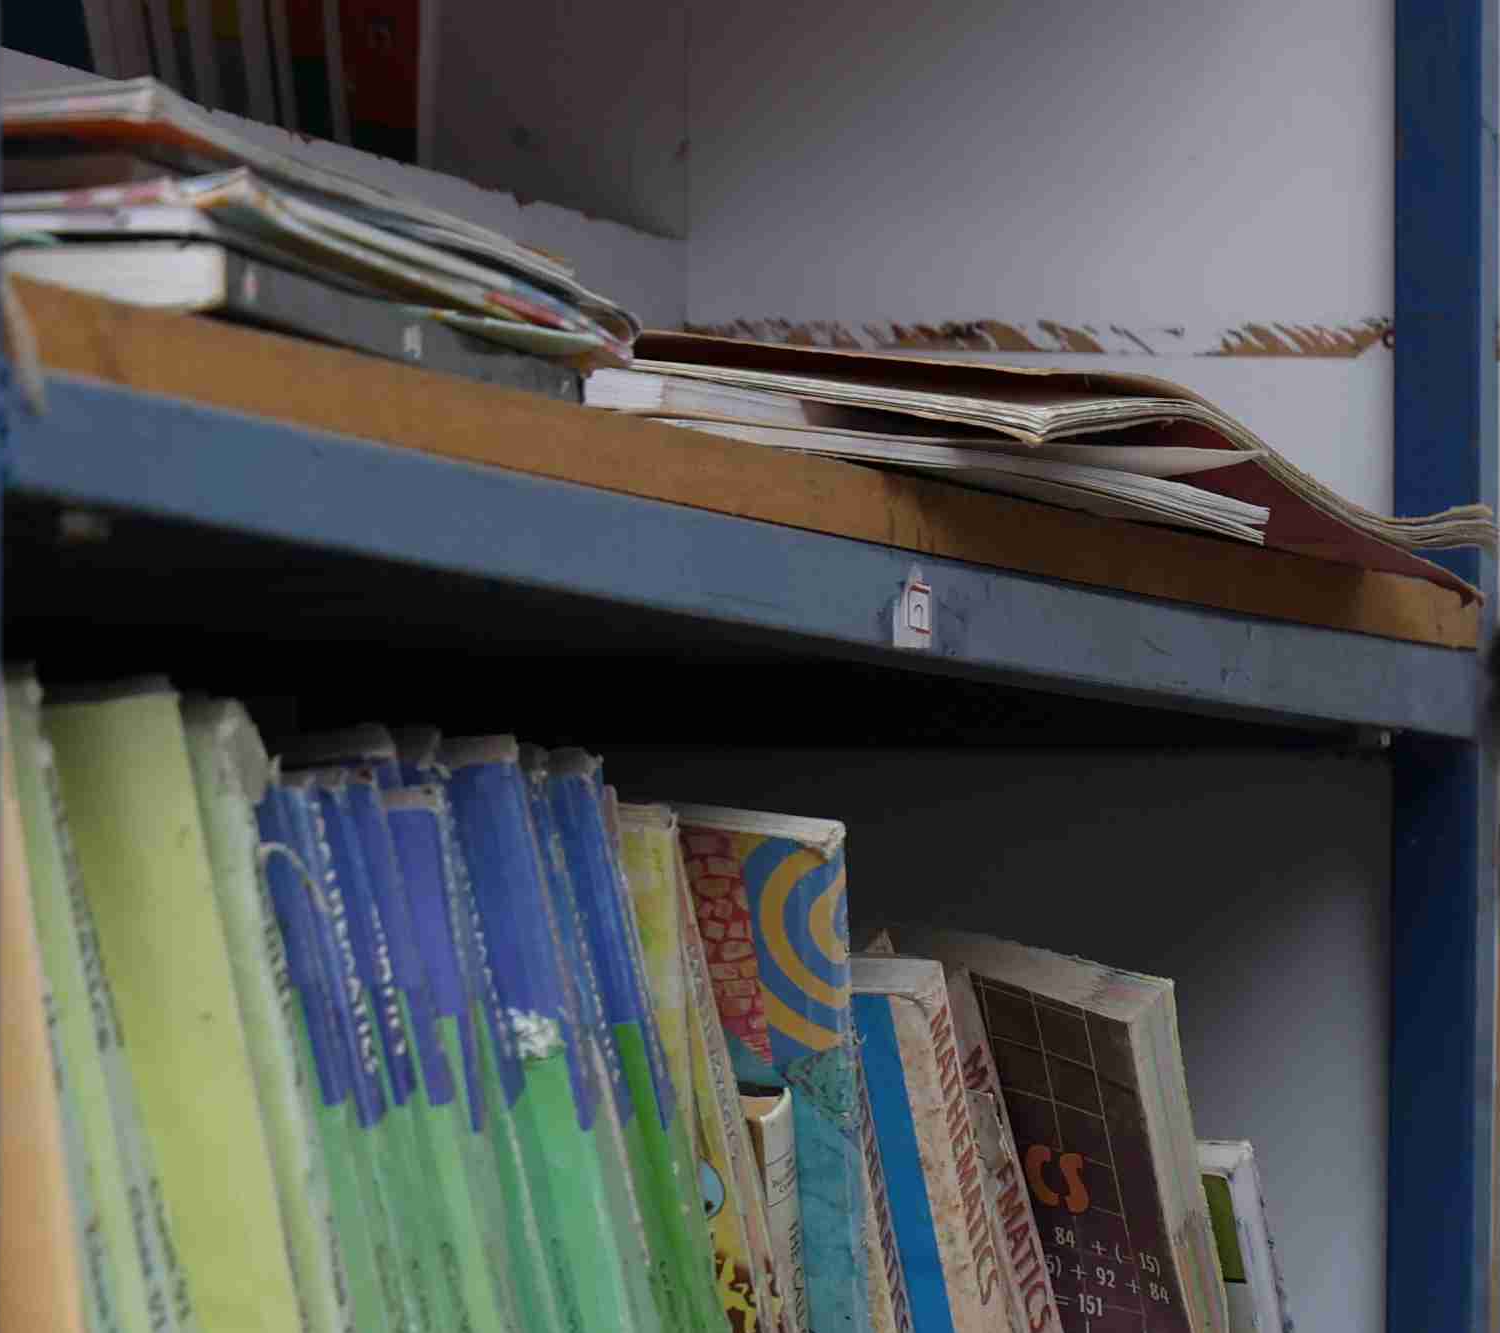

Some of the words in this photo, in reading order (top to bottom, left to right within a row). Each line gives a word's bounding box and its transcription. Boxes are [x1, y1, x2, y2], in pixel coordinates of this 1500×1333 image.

[930, 1004, 999, 1305] MATHEMATICS
[1054, 1226, 1076, 1248] 84
[793, 1265, 806, 1326] CALL
[1096, 1266, 1117, 1290] 92
[1149, 1281, 1172, 1306] 84
[1078, 1294, 1103, 1319] 151
